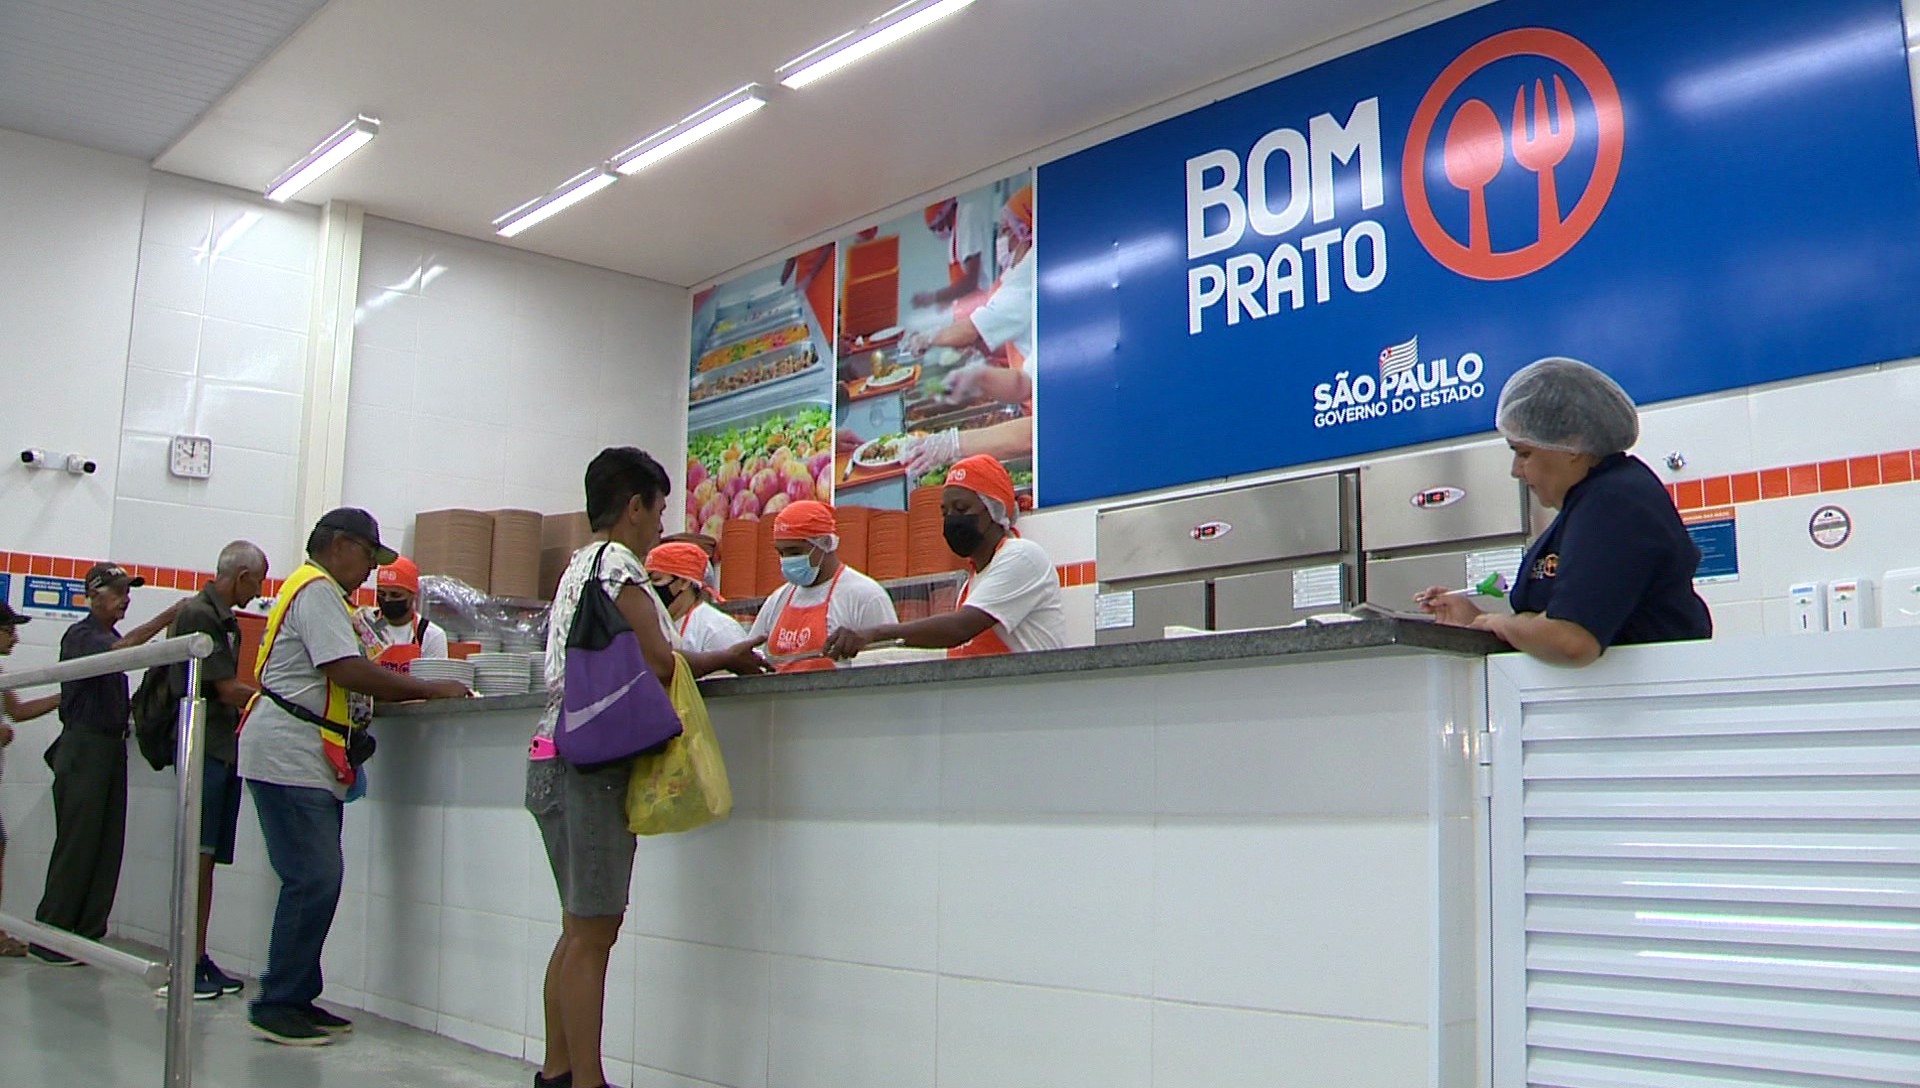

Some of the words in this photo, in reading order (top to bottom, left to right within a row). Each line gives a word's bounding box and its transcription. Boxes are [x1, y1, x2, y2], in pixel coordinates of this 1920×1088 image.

[1186, 97, 1384, 260] BOM
[1188, 220, 1388, 335] PRATO
[1314, 370, 1376, 412] SÃO
[1379, 352, 1484, 400] PAULO
[1314, 401, 1388, 429] GOVERNO
[1392, 396, 1416, 414] DO
[1420, 382, 1485, 408] ESTADO
